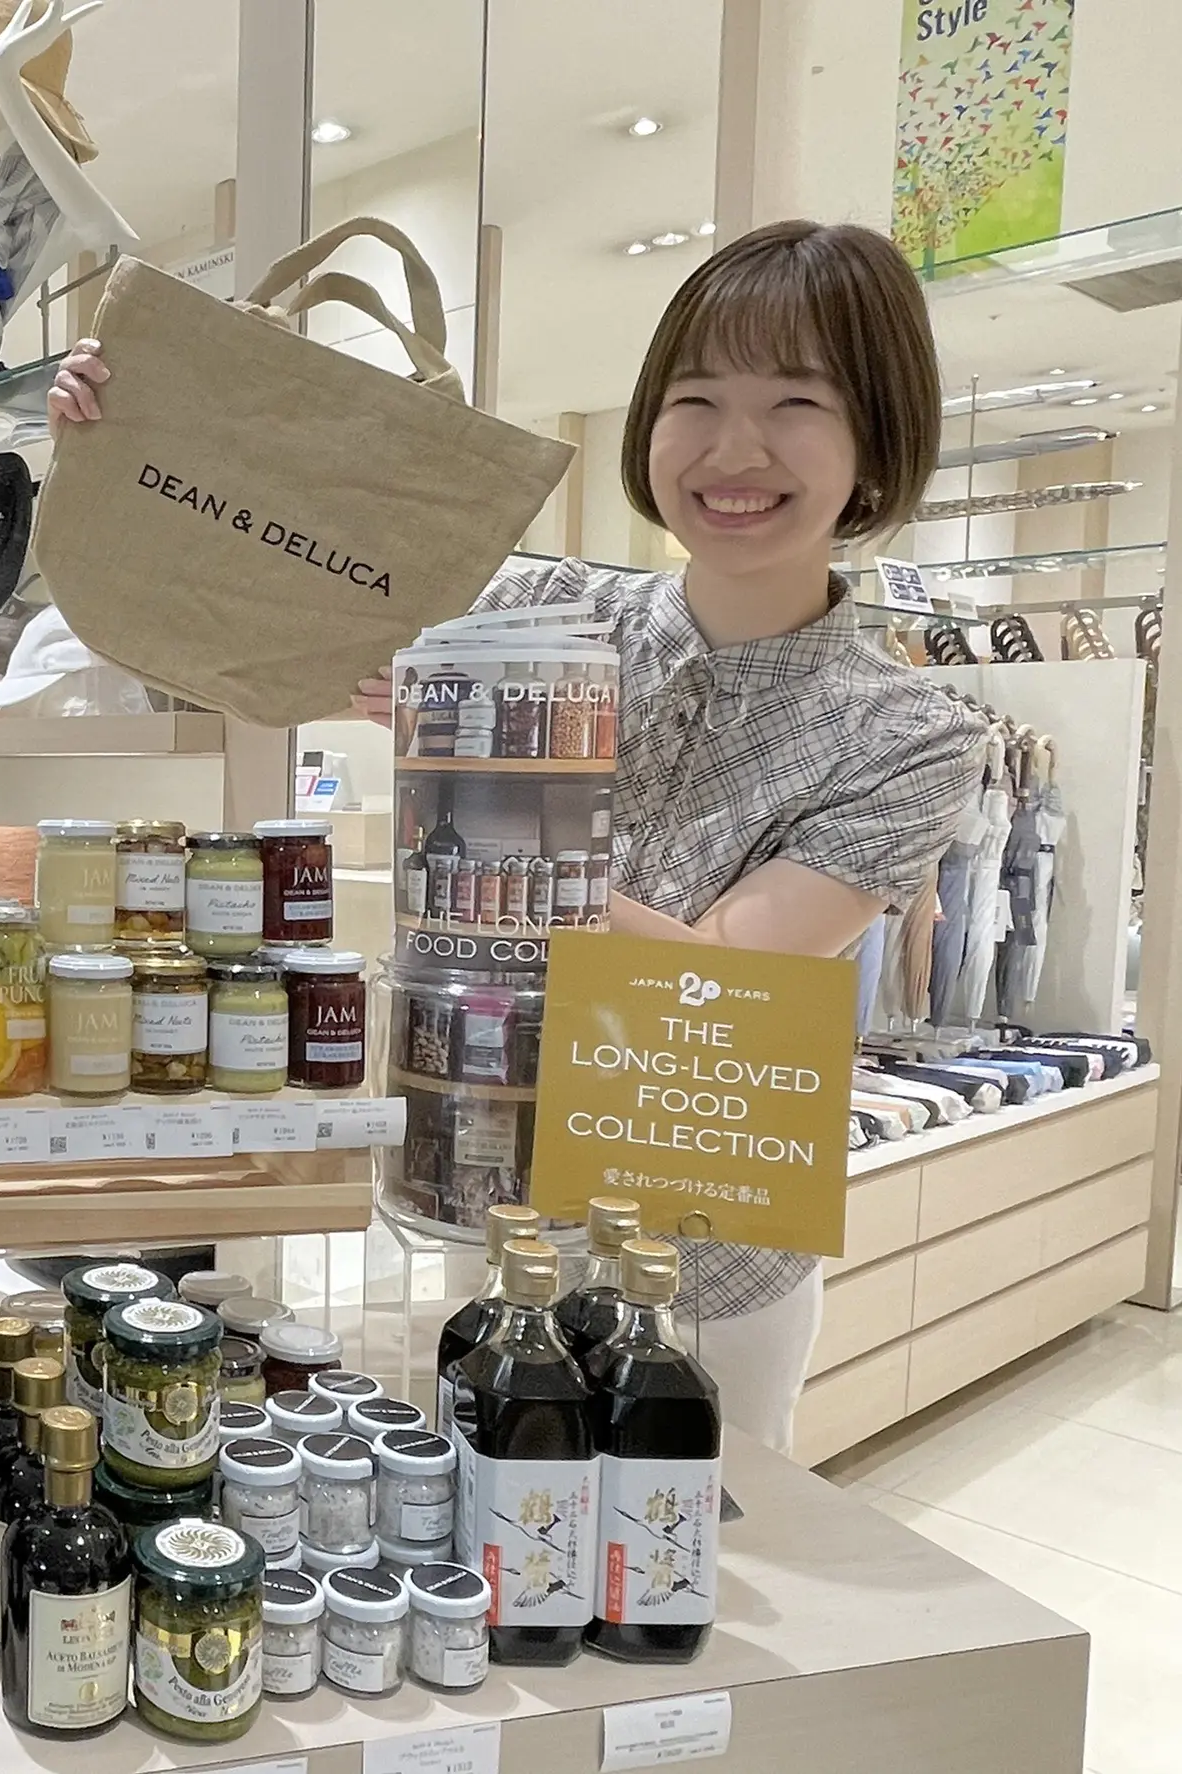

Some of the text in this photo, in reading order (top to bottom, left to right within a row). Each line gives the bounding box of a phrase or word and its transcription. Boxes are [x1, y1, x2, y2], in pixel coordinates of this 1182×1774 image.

[918, 0, 988, 41] Style
[138, 463, 393, 598] DEAN & DELUCA
[397, 681, 612, 704] DEAN & DELUCA
[293, 866, 328, 887] JAM
[405, 931, 477, 959] FOOD
[629, 971, 771, 1007] JAPAN 20 YEARS
[76, 1012, 118, 1032] JAM
[307, 1028, 329, 1036] DEAN
[316, 1006, 358, 1026] JAM
[660, 1016, 734, 1049] THE
[571, 1041, 821, 1093] LONG-LOVED
[637, 1085, 748, 1121] FOOD
[567, 1112, 814, 1167] COLLECTION
[603, 1167, 772, 1207] 愛されつづける定番品
